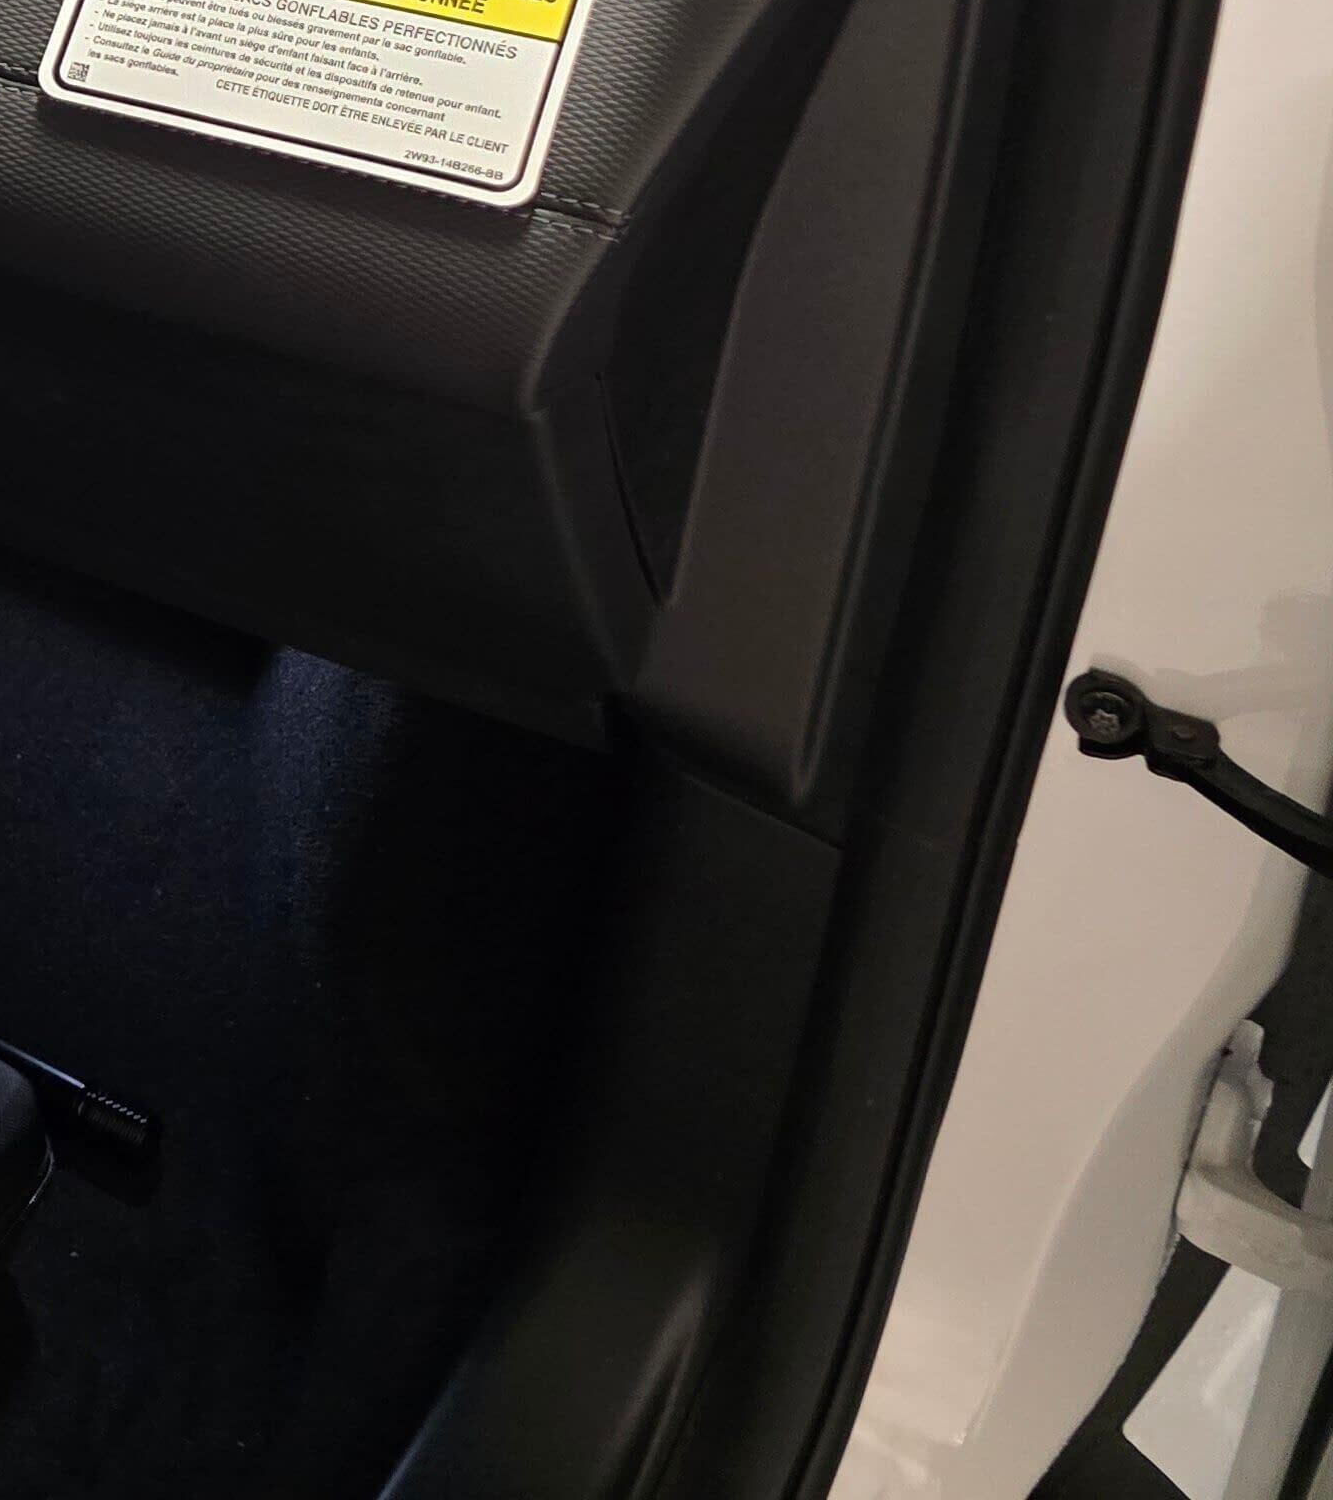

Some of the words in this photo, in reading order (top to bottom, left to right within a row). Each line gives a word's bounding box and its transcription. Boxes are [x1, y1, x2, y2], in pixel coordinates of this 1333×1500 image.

[102, 9, 116, 19] Ne
[116, 13, 148, 26] placez
[147, 18, 180, 32] jamais
[181, 24, 188, 34] à
[224, 36, 237, 45] un
[310, 52, 345, 69] faisant
[346, 60, 369, 74] face
[370, 65, 377, 76] à
[133, 30, 173, 45] toujours
[174, 38, 189, 49] les
[191, 43, 237, 60] ceintures
[238, 53, 252, 63] de
[295, 66, 306, 76] et
[306, 67, 322, 79] les
[324, 72, 377, 91] dispositifs
[379, 84, 393, 95] de
[394, 88, 435, 104] retenue
[436, 98, 464, 109] pour
[382, 20, 518, 59] PERFECTIONNÉS
[216, 79, 251, 95] CETTE
[311, 100, 339, 115] DOIT
[423, 126, 448, 140] PAR
[449, 132, 465, 144] LE
[466, 136, 509, 154] CLIENT
